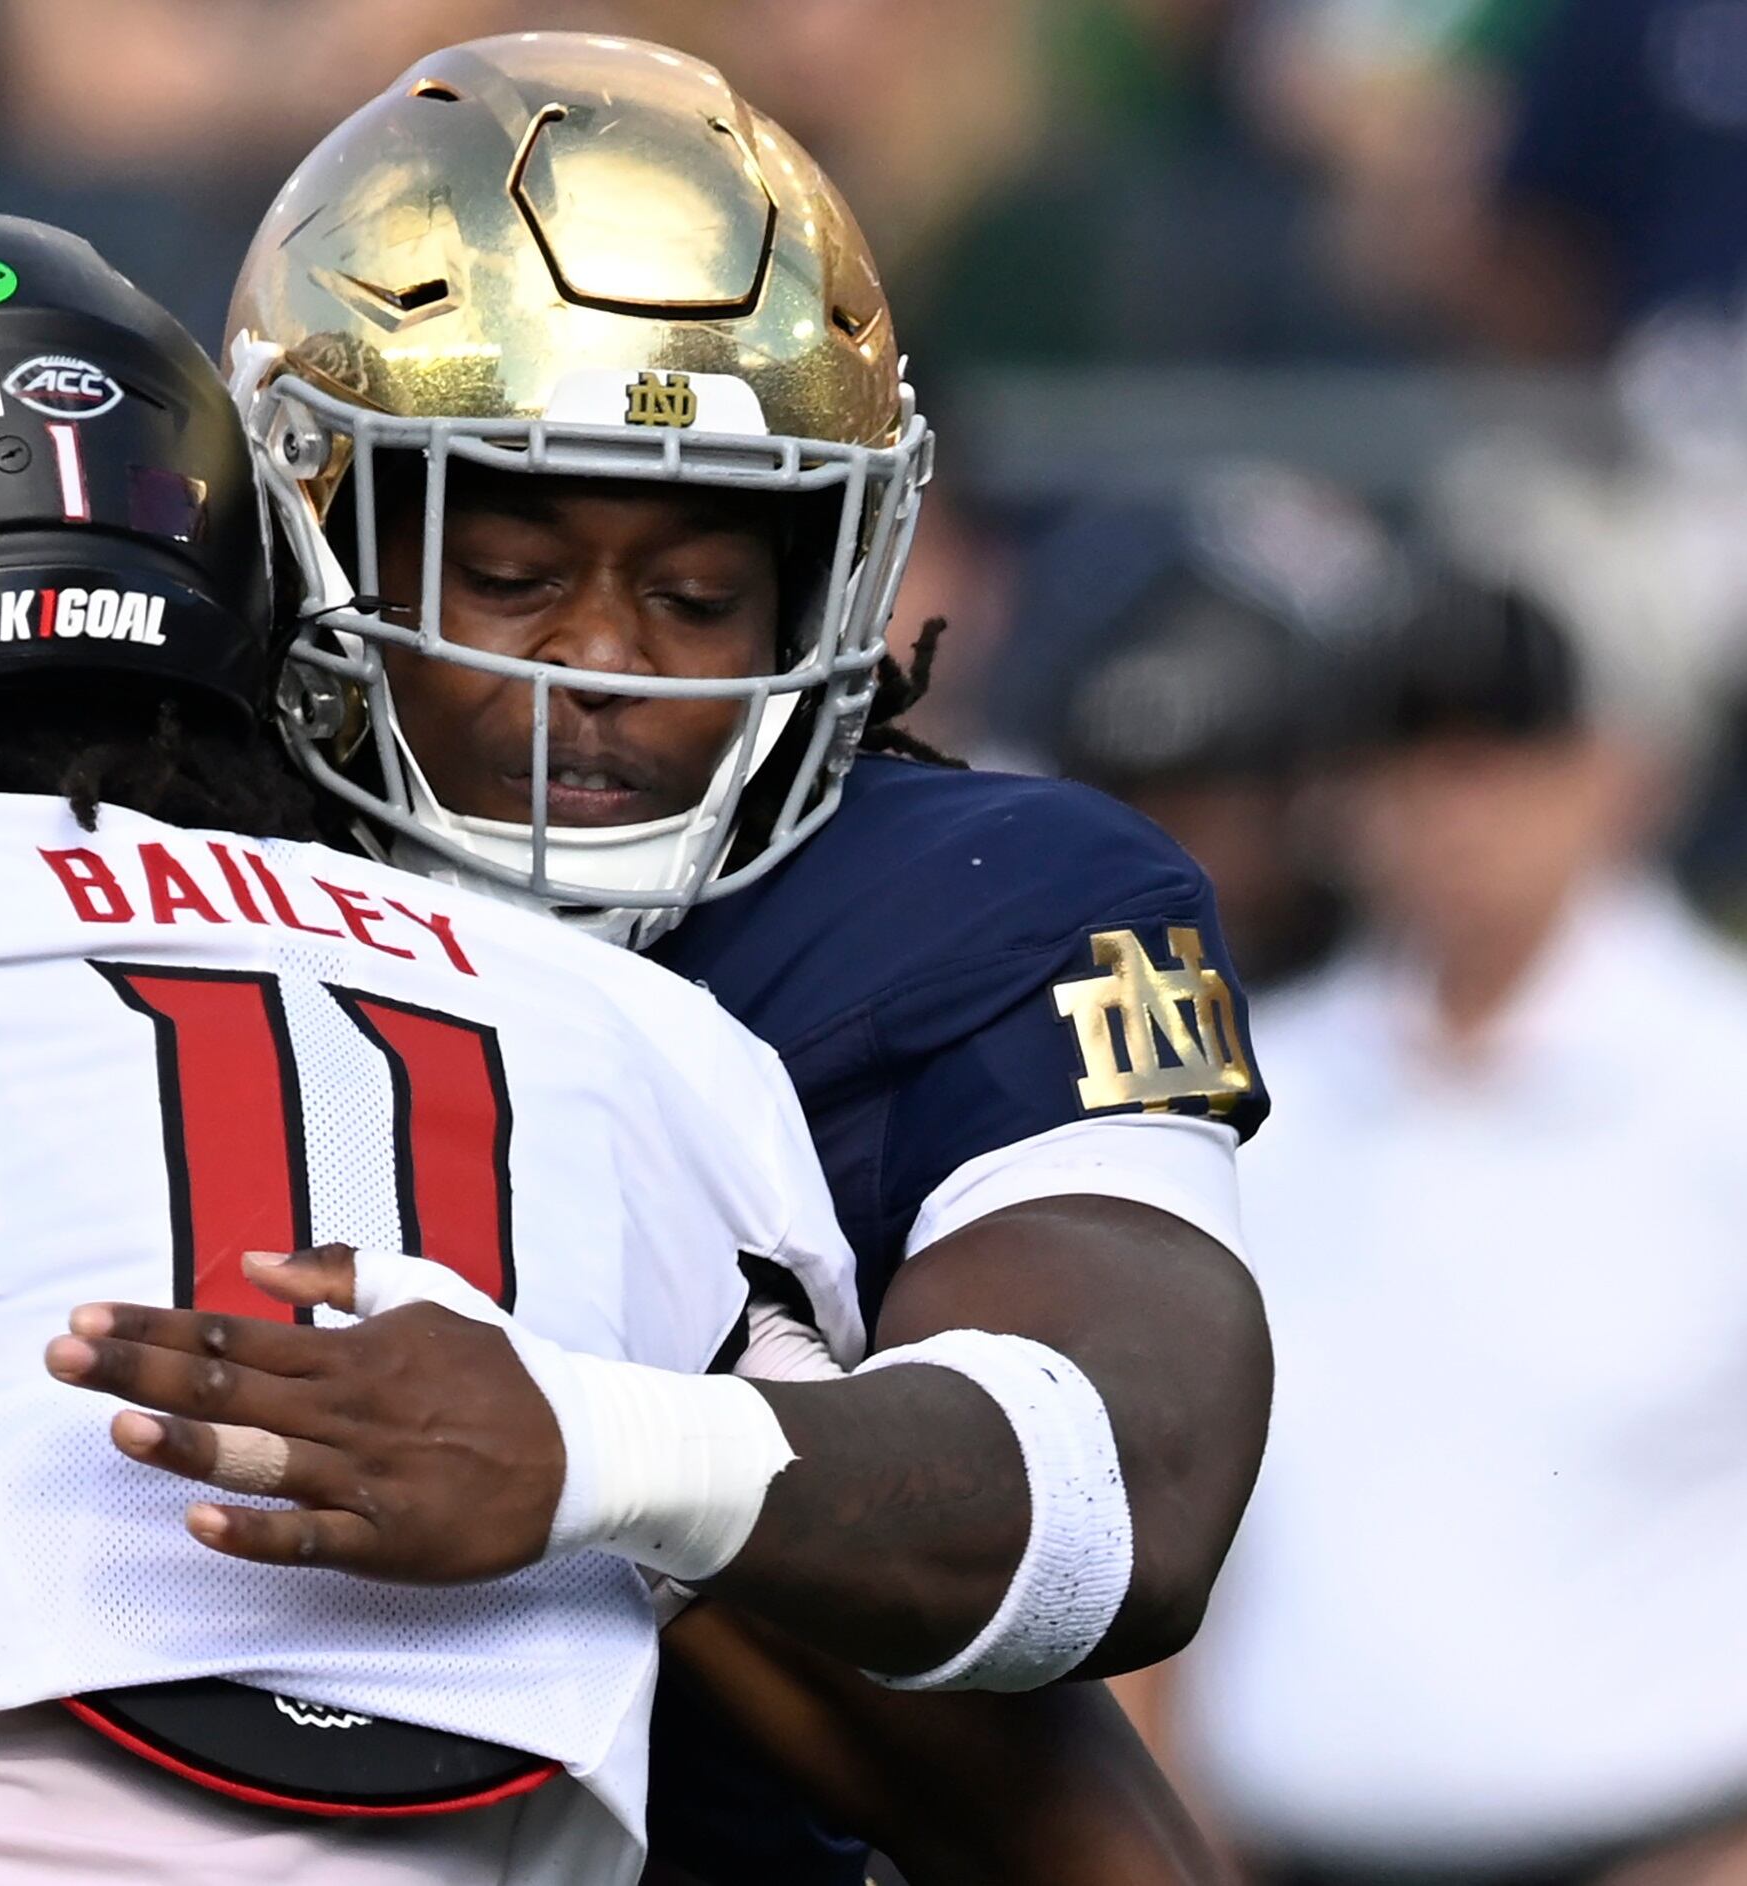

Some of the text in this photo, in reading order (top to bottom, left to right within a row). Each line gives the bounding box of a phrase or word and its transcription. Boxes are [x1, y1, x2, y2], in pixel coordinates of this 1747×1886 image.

[25, 370, 103, 397] ACC
[38, 841, 478, 977] BAILEY
[84, 958, 517, 1325] 11
